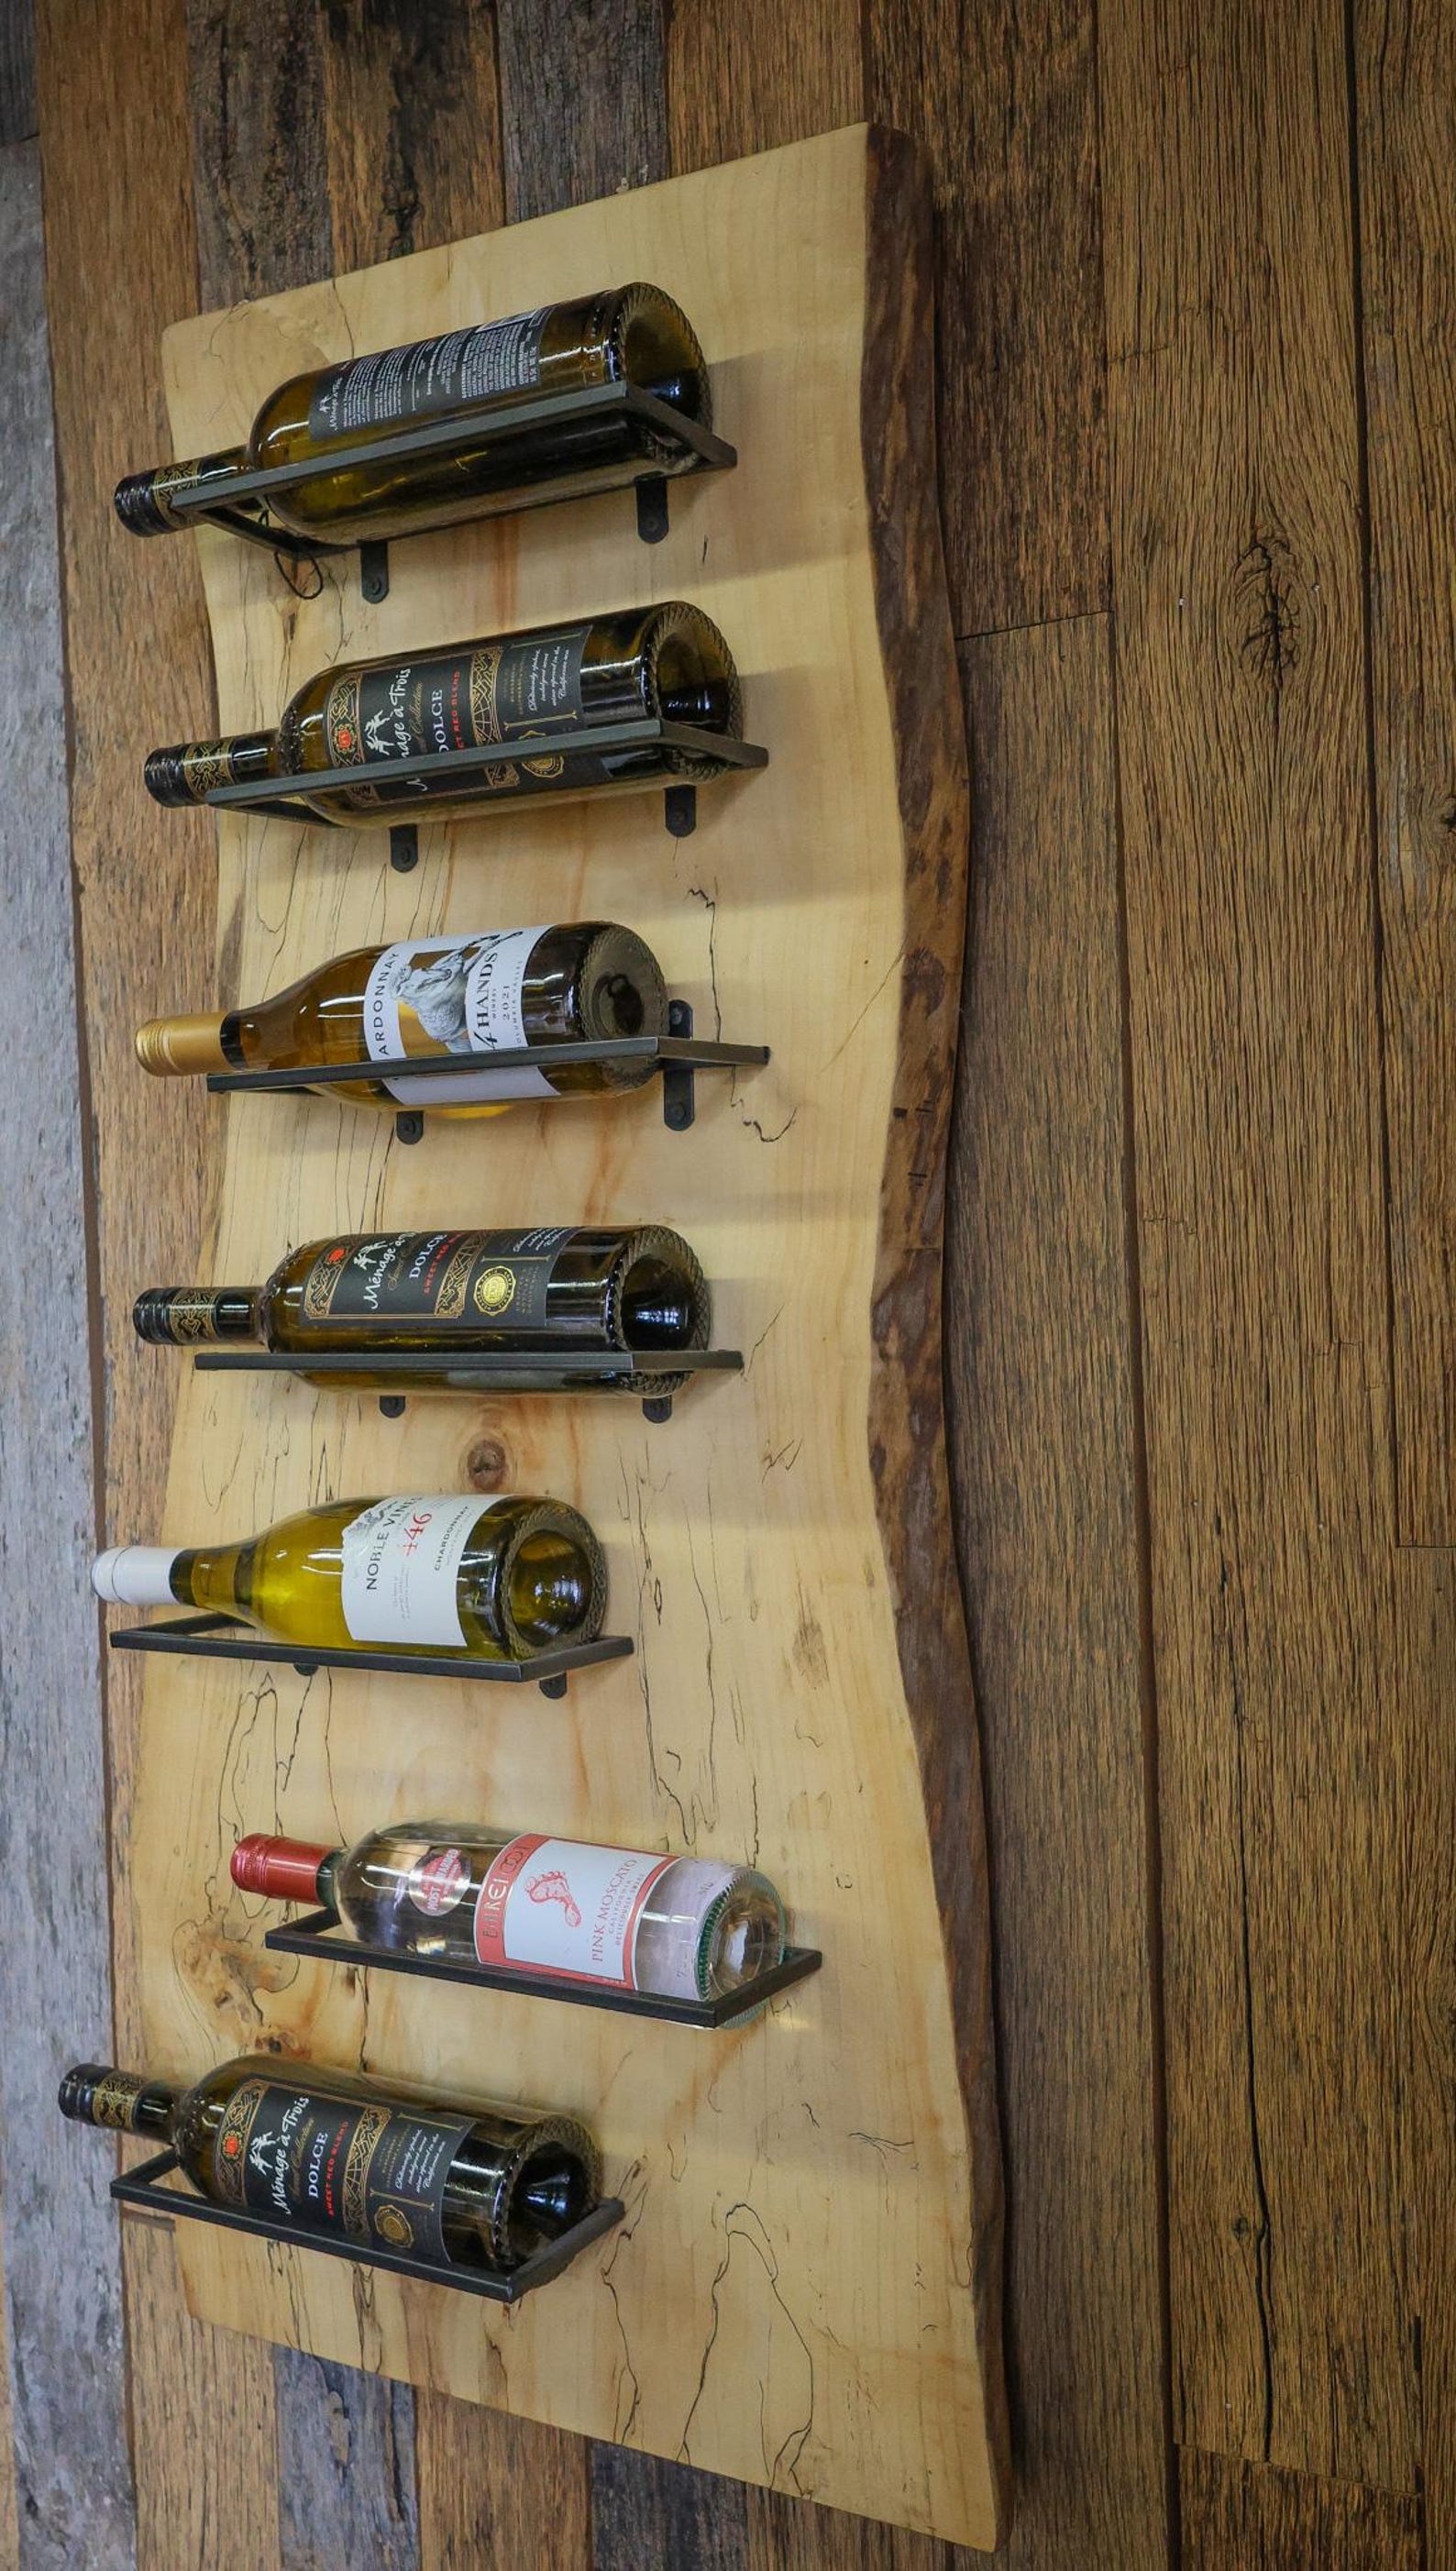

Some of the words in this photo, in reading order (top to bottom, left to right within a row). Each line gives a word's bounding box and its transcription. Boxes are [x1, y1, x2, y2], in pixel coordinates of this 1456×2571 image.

[389, 668, 412, 706] Trois
[372, 953, 400, 1056] ARDONNAY
[476, 951, 498, 1029] HANDS
[502, 985, 511, 1021] 2021
[473, 1032, 498, 1051] 4
[512, 999, 522, 1043] OLUMBIA
[363, 1247, 396, 1309] Ménage
[367, 1532, 390, 1590] NOBLE
[434, 1506, 469, 1572] CHARDONNAY
[436, 1848, 459, 1880] WARDED
[591, 1924, 605, 1962] PINK
[598, 1859, 638, 1921] MOSCATO
[276, 2133, 291, 2146] à
[281, 2096, 310, 2133] Trois
[331, 2120, 349, 2156] BLEND
[271, 2148, 292, 2215] Ménage
[308, 2132, 329, 2199] DOLCE
